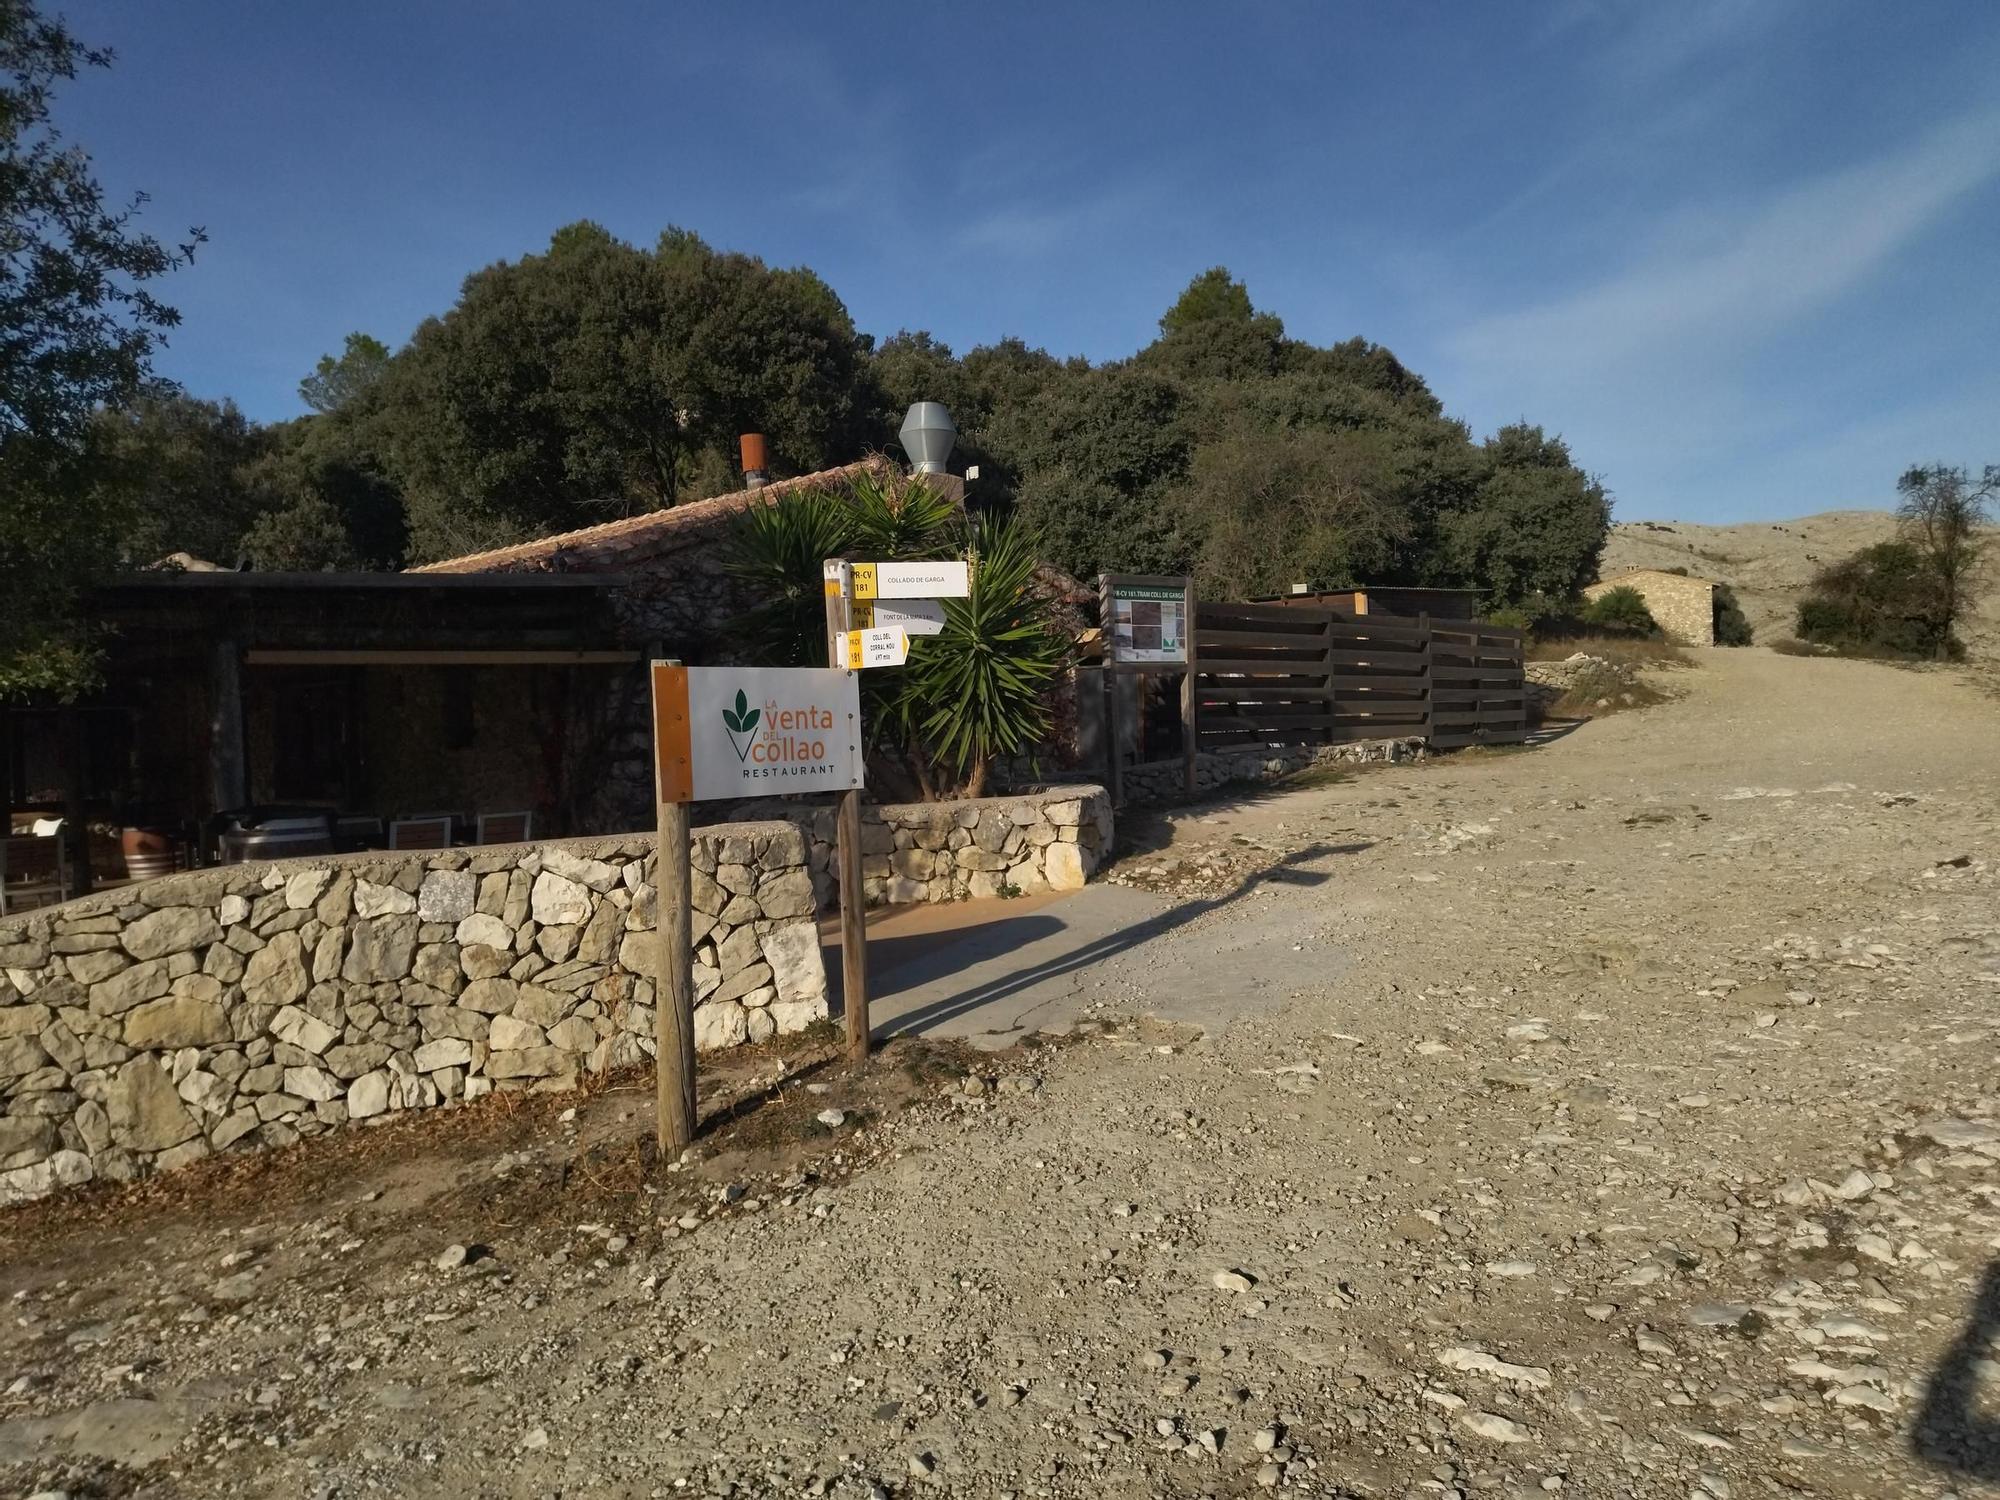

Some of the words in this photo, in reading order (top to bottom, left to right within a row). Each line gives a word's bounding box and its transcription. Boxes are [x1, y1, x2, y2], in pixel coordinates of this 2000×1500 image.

[856, 584, 868, 592] 181
[851, 652, 861, 663] 181
[765, 699, 778, 709] LA
[762, 732, 782, 741] DEL
[751, 736, 825, 763] collao
[743, 765, 835, 779] RESTAURANT
